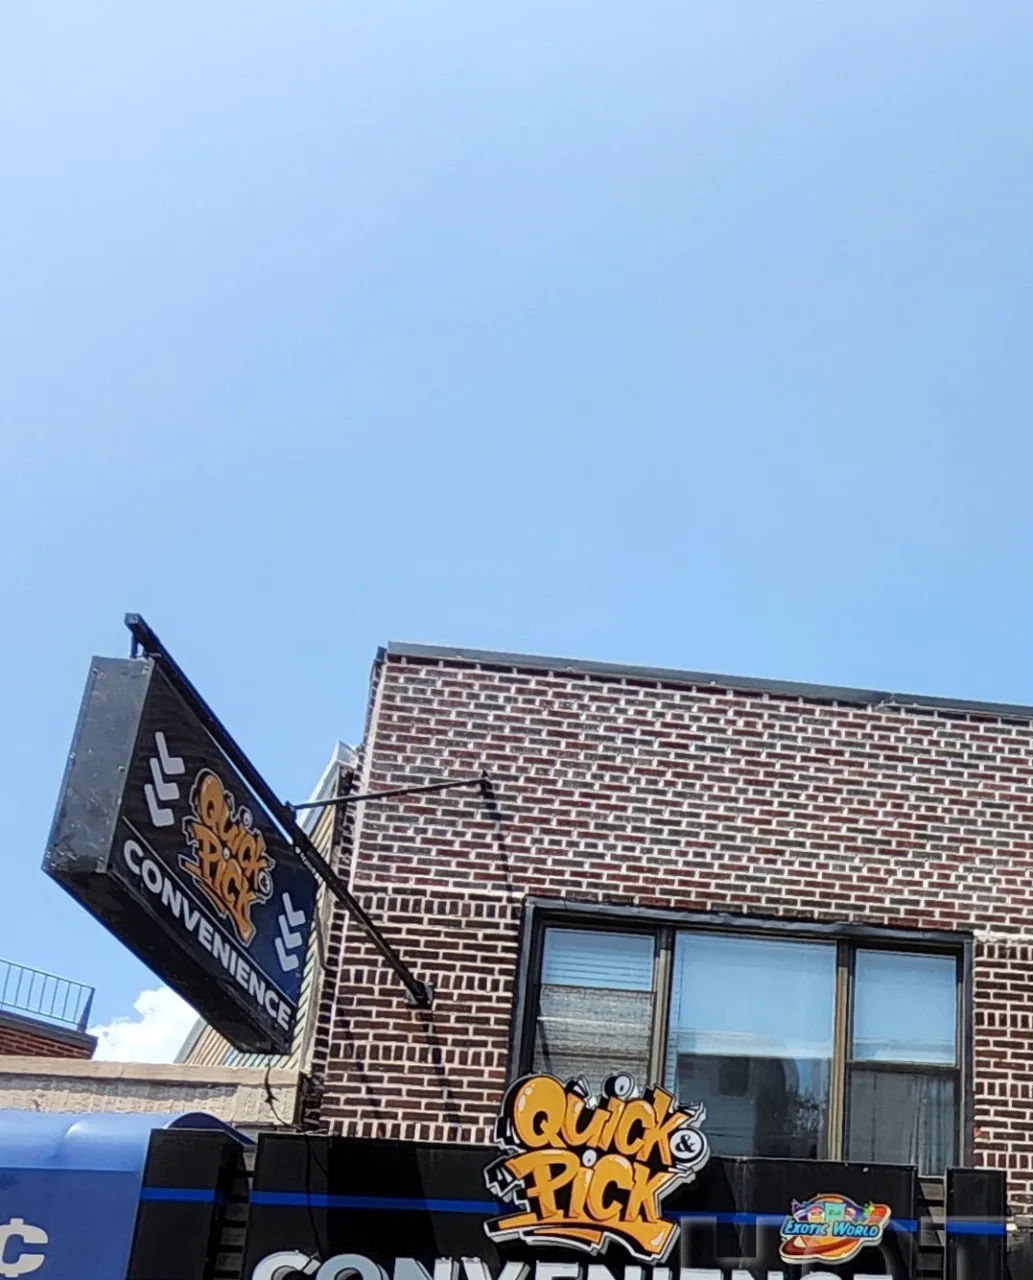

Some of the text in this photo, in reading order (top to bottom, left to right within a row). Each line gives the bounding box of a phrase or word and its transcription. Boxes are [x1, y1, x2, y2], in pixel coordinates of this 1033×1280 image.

[123, 839, 292, 1031] CONVENIENCE
[674, 1134, 696, 1154] &
[784, 1220, 879, 1237] EXOTIC WORLD
